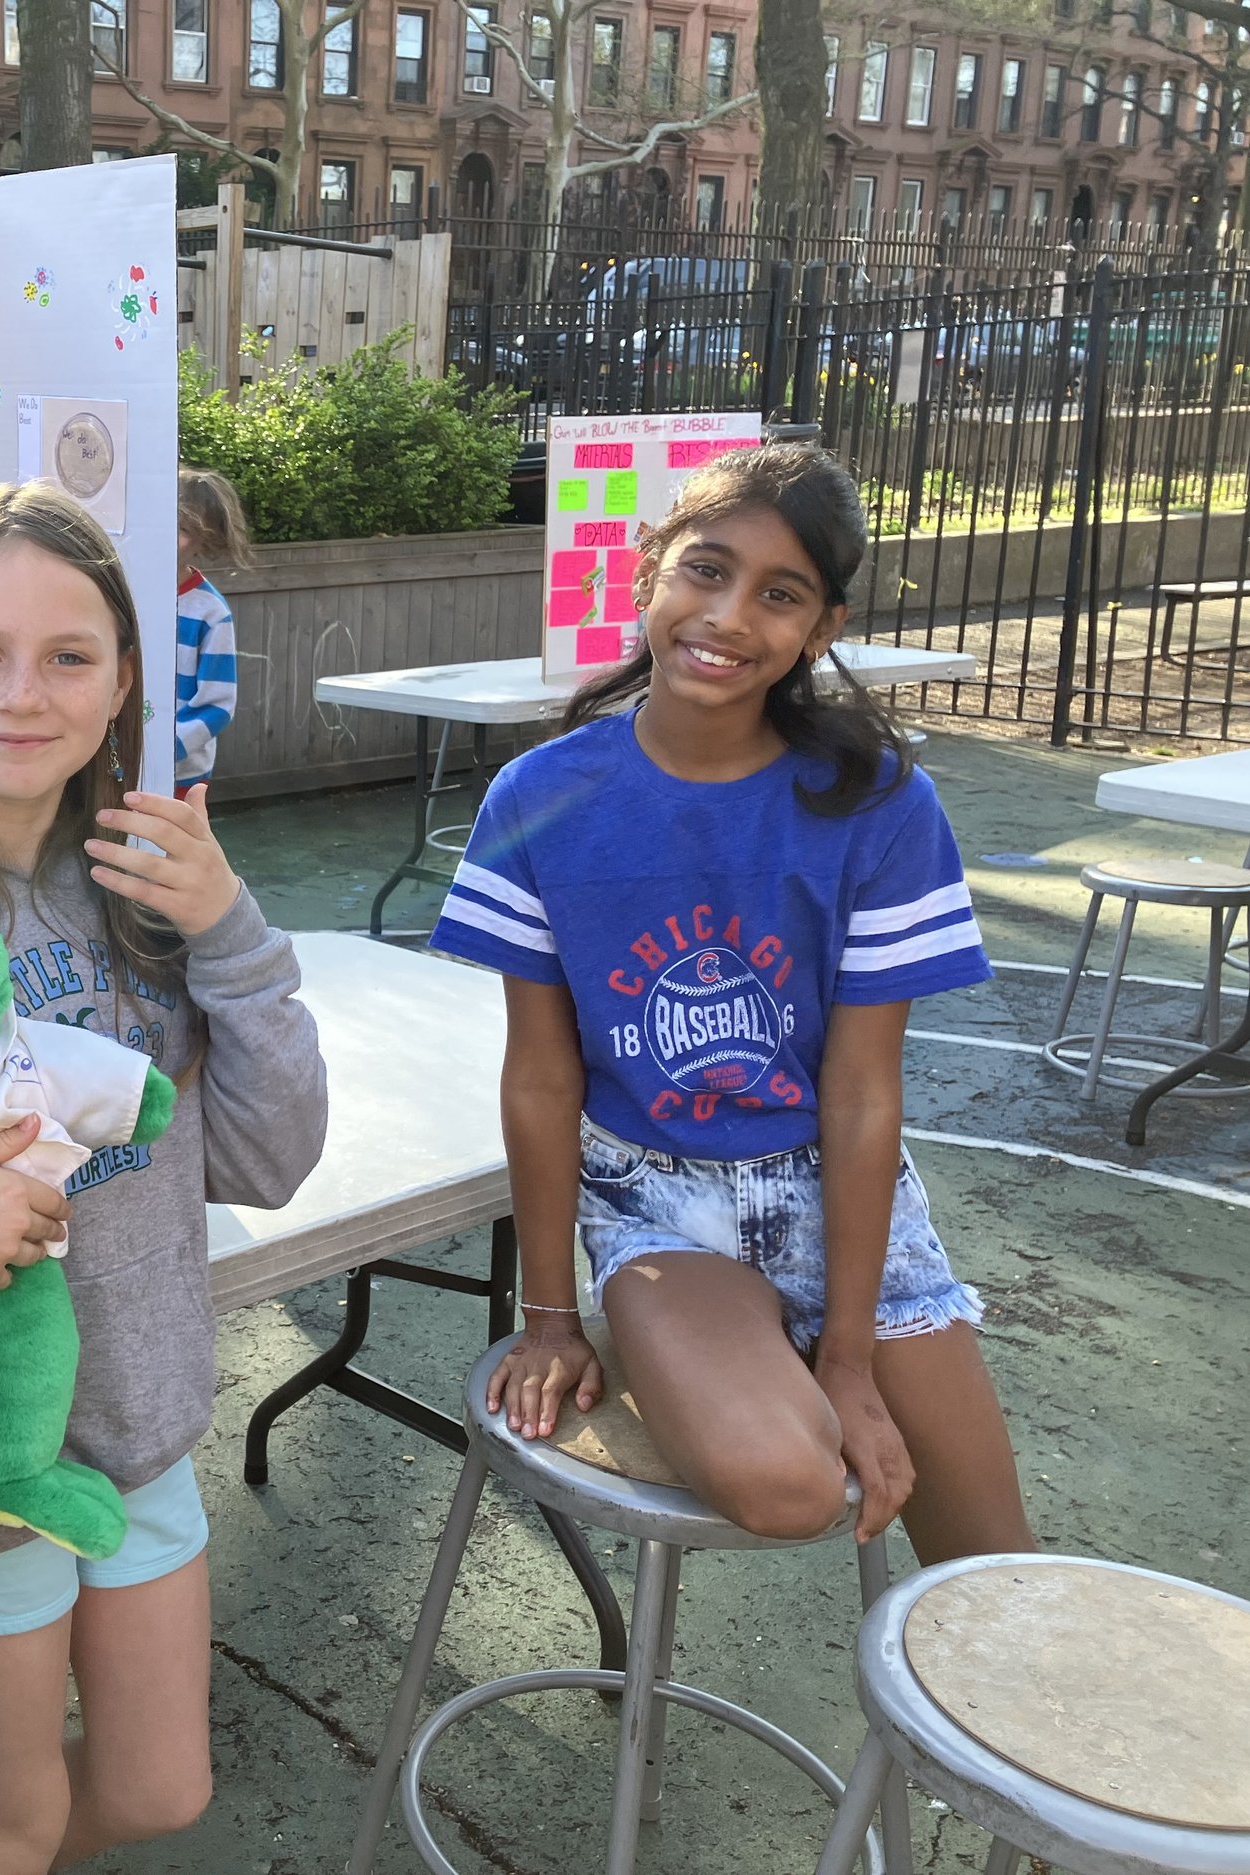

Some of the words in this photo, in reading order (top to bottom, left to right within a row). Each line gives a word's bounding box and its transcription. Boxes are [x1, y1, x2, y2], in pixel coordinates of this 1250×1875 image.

[582, 522, 618, 546] DATA
[609, 1023, 641, 1058] 18
[654, 993, 776, 1061] BASEBALL
